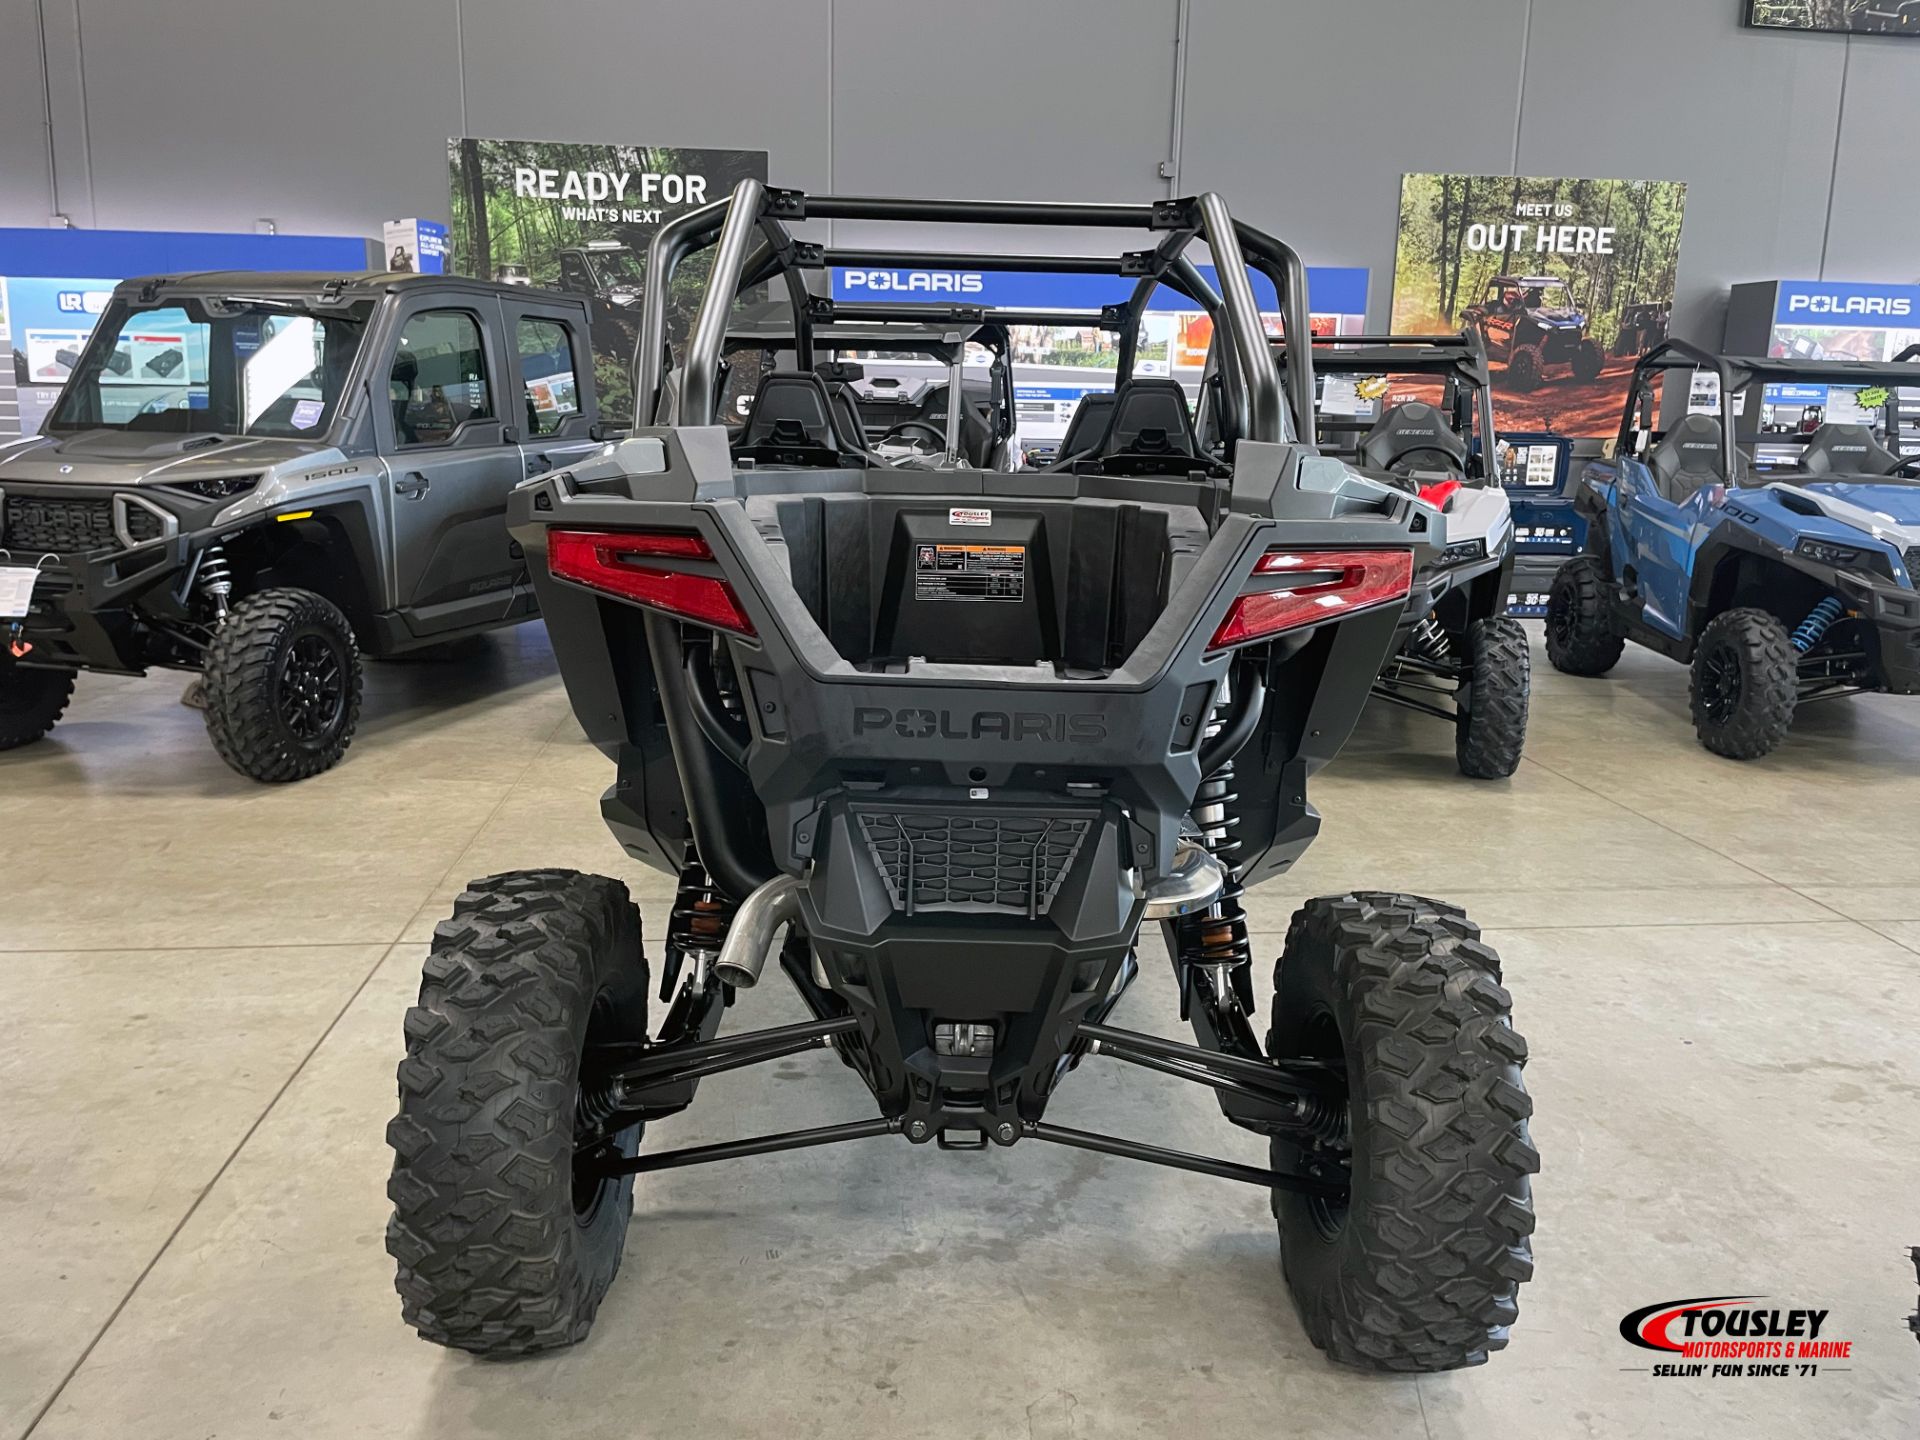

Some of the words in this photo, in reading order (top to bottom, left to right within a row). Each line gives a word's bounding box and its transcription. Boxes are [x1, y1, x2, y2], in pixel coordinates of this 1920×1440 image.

[515, 168, 630, 202] READY
[641, 173, 707, 204] FOR
[562, 207, 619, 222] WHAT'S
[622, 209, 662, 224] NEXT
[1516, 203, 1552, 217] MEET
[1555, 204, 1573, 217] US
[1467, 223, 1529, 252] OUT
[1536, 225, 1616, 254] HERE
[844, 271, 984, 293] POLARIS
[1789, 294, 1912, 316] POLARIS
[304, 466, 358, 481] 1500
[7, 508, 110, 529] POLARIS
[853, 707, 1107, 743] POLARIS
